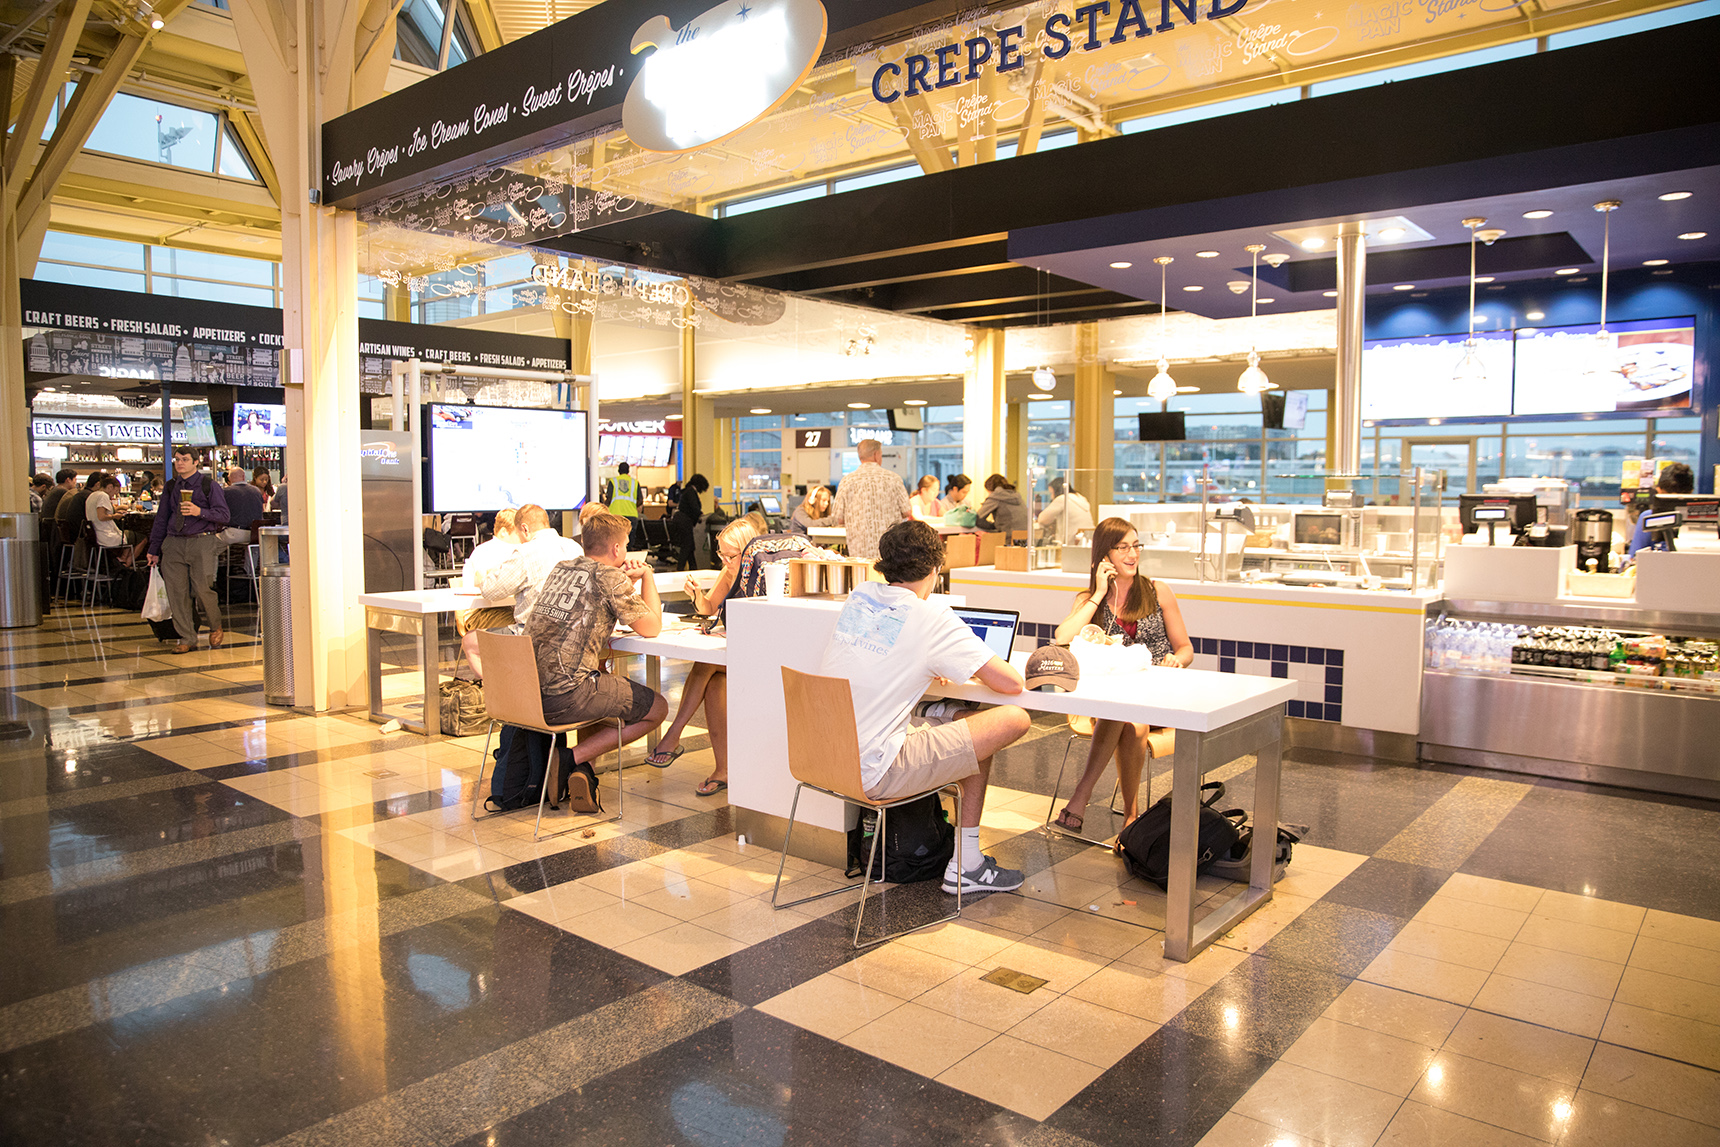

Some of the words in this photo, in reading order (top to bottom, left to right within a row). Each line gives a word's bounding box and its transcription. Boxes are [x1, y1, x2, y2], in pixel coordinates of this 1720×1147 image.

[1425, 0, 1477, 24] Stan
[676, 22, 700, 46] the
[960, 13, 994, 40] Stand
[1236, 23, 1281, 49] Crêpe
[1358, 17, 1400, 42] PAN
[1242, 33, 1288, 65] Stand
[871, 25, 1025, 104] CREPE
[1085, 61, 1122, 84] Crêpe
[1033, 77, 1082, 101] MAGIC
[1090, 70, 1129, 99] Stand
[955, 93, 989, 115] Crêpe
[960, 101, 993, 129] Stand
[1042, 94, 1072, 112] PAN
[331, 159, 364, 186] Savory
[366, 145, 399, 177] Crêpes
[407, 126, 428, 158] Ice
[431, 120, 469, 149] Cream
[473, 102, 509, 134] Cones
[521, 82, 562, 117] Sweet
[567, 64, 615, 105] Crêpes
[845, 120, 874, 142] Crêpe
[912, 110, 954, 129] MAGIC
[919, 121, 946, 140] PAN
[850, 129, 878, 154] Stand
[25, 309, 62, 326] CRAFT
[64, 313, 99, 330] BEERS
[110, 318, 143, 334] FRESH
[144, 321, 182, 338] SALADS
[192, 326, 246, 343] APPETIZERS
[359, 342, 391, 356] ARTISAN
[391, 344, 415, 358] WINES
[425, 348, 448, 361] CRAFT
[449, 350, 471, 363] BEERS
[479, 352, 500, 365] FRESH
[501, 354, 526, 367] SALADS
[531, 357, 567, 370] APPETIZERS
[35, 422, 102, 437] EBANESE
[107, 424, 164, 439] TAVERN
[804, 430, 822, 448] 27
[549, 608, 570, 621] SHIRT
[860, 639, 890, 657] vines
